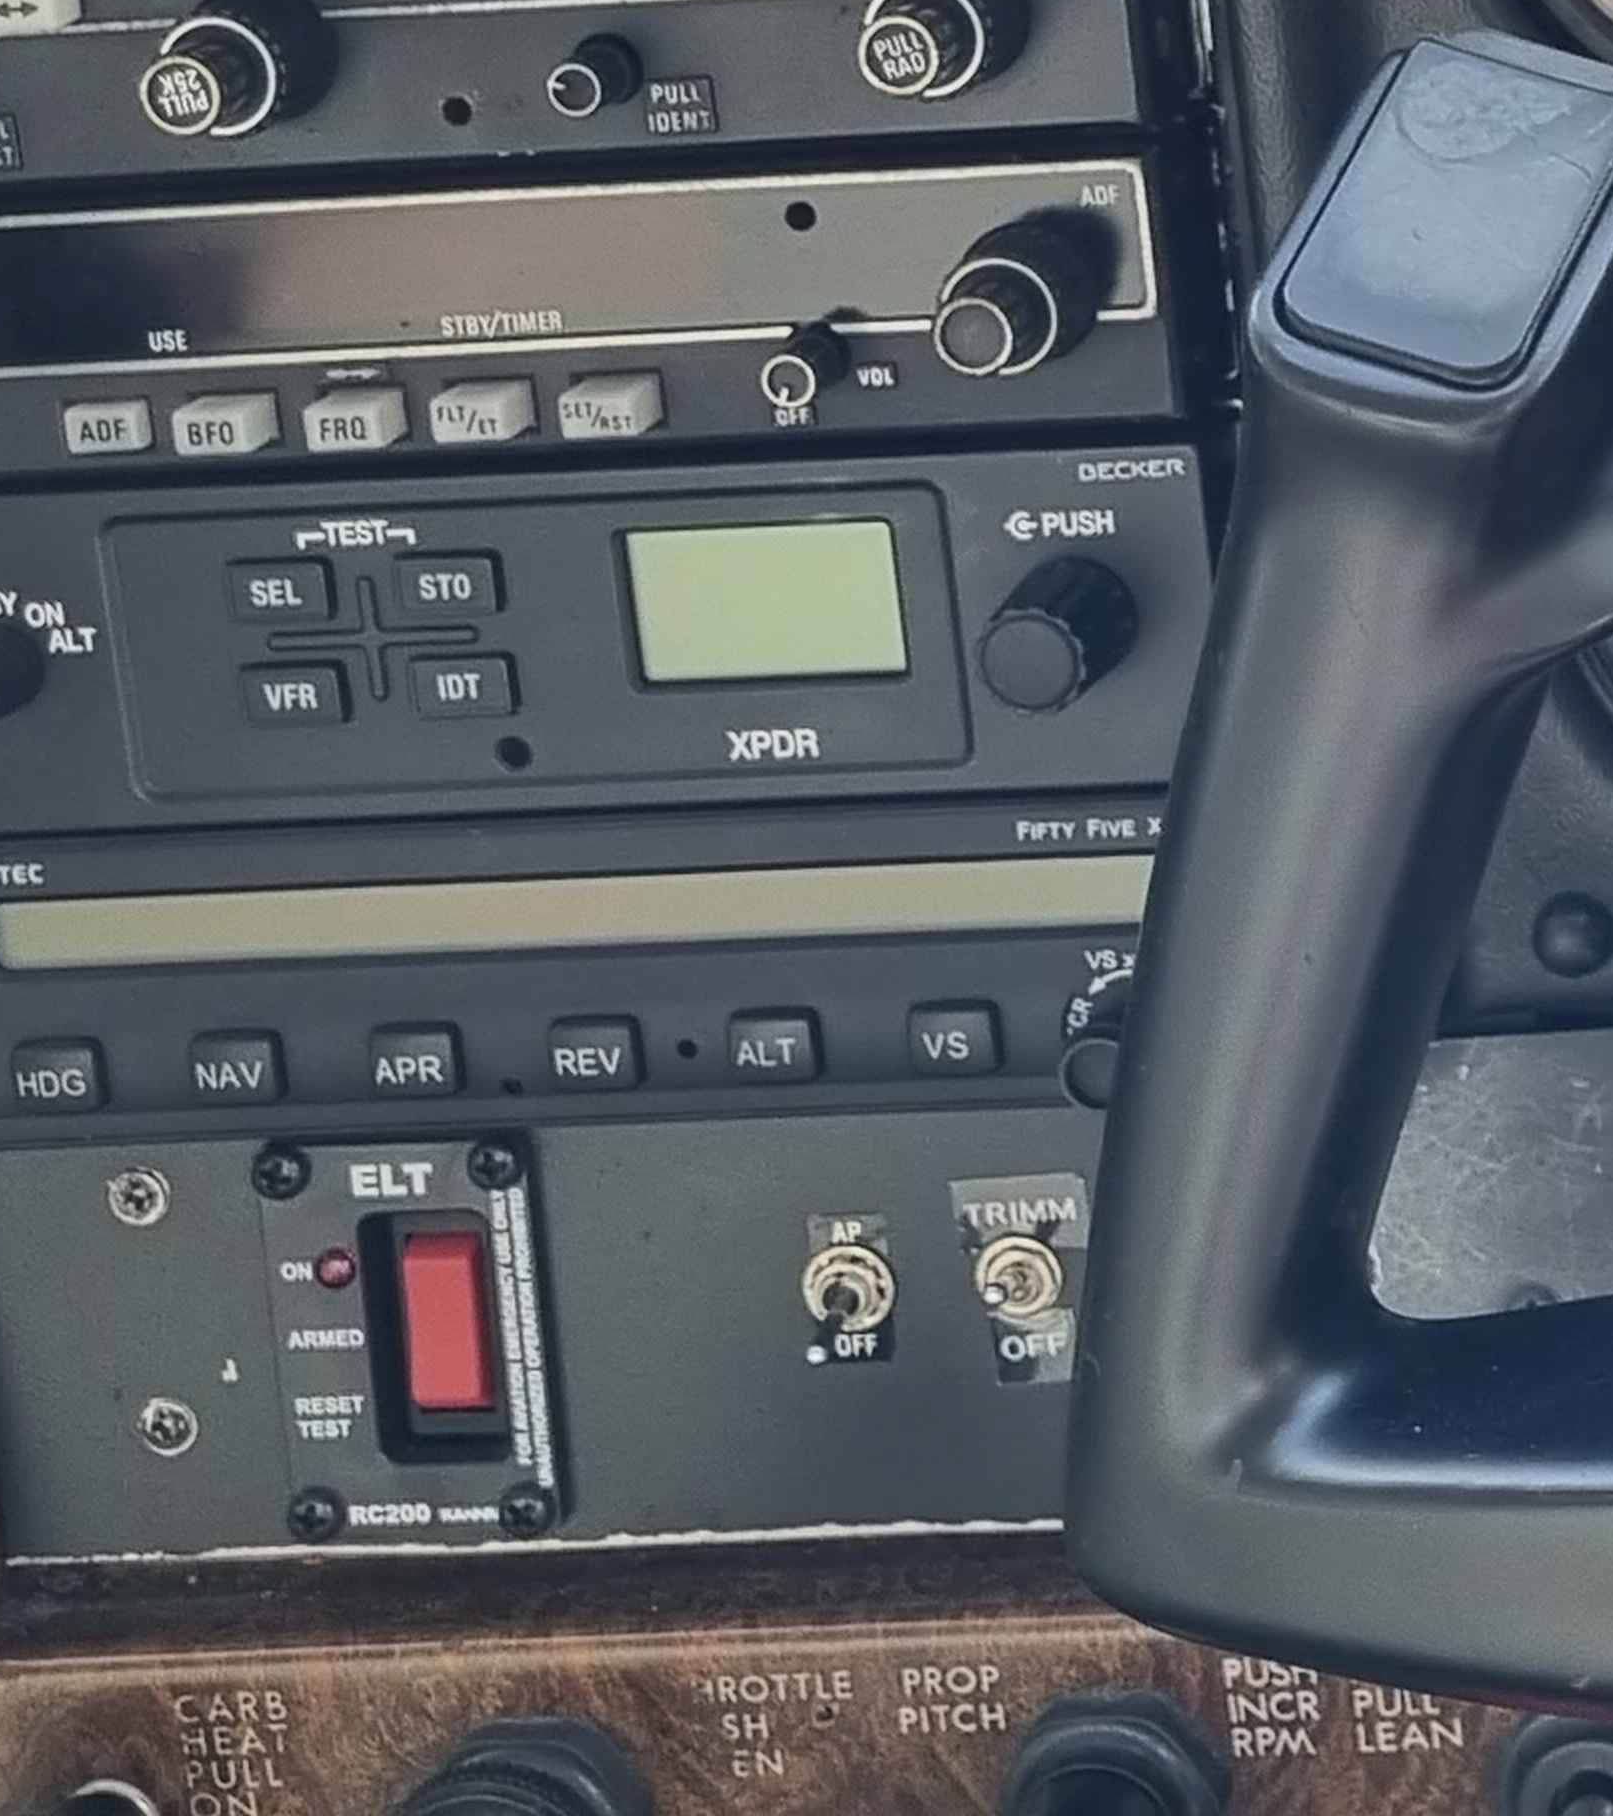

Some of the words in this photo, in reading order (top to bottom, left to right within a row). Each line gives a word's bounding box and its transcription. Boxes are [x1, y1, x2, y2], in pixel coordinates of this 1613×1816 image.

[440, 311, 562, 339] STBY/TIMER
[81, 419, 128, 443] ADF
[187, 421, 234, 446] BFO
[318, 416, 367, 443] FRQ
[321, 520, 387, 547] TEST
[1041, 512, 1114, 536] PUSH
[250, 579, 302, 606] SEL
[25, 602, 64, 627] ON
[49, 629, 96, 653] ALT
[264, 684, 318, 711] VFR
[437, 674, 480, 700] IDT
[727, 729, 820, 760] XPDR
[736, 1038, 797, 1067] ALT
[922, 1033, 968, 1059] VS
[374, 1057, 443, 1085] APR
[554, 1046, 622, 1075] REV
[17, 1070, 86, 1098] HDG
[195, 1061, 262, 1089] NAV
[349, 1162, 433, 1197] ELT
[963, 1198, 1077, 1226] TRIMM
[832, 1222, 861, 1244] AP
[288, 1328, 364, 1349] ARMED
[834, 1332, 878, 1357] OFF
[1000, 1333, 1065, 1364] OFF
[295, 1396, 364, 1415] RESET
[298, 1419, 352, 1438] TEST
[348, 1504, 431, 1525] RC200
[901, 1666, 999, 1695] PROP
[176, 1693, 287, 1723] CARB
[898, 1706, 1006, 1734] PITCH
[1228, 1692, 1318, 1723] INCR
[183, 1725, 286, 1754] HEAT
[1233, 1726, 1316, 1757] RPM
[1358, 1720, 1464, 1753] LEAN
[188, 1758, 282, 1788] PULL
